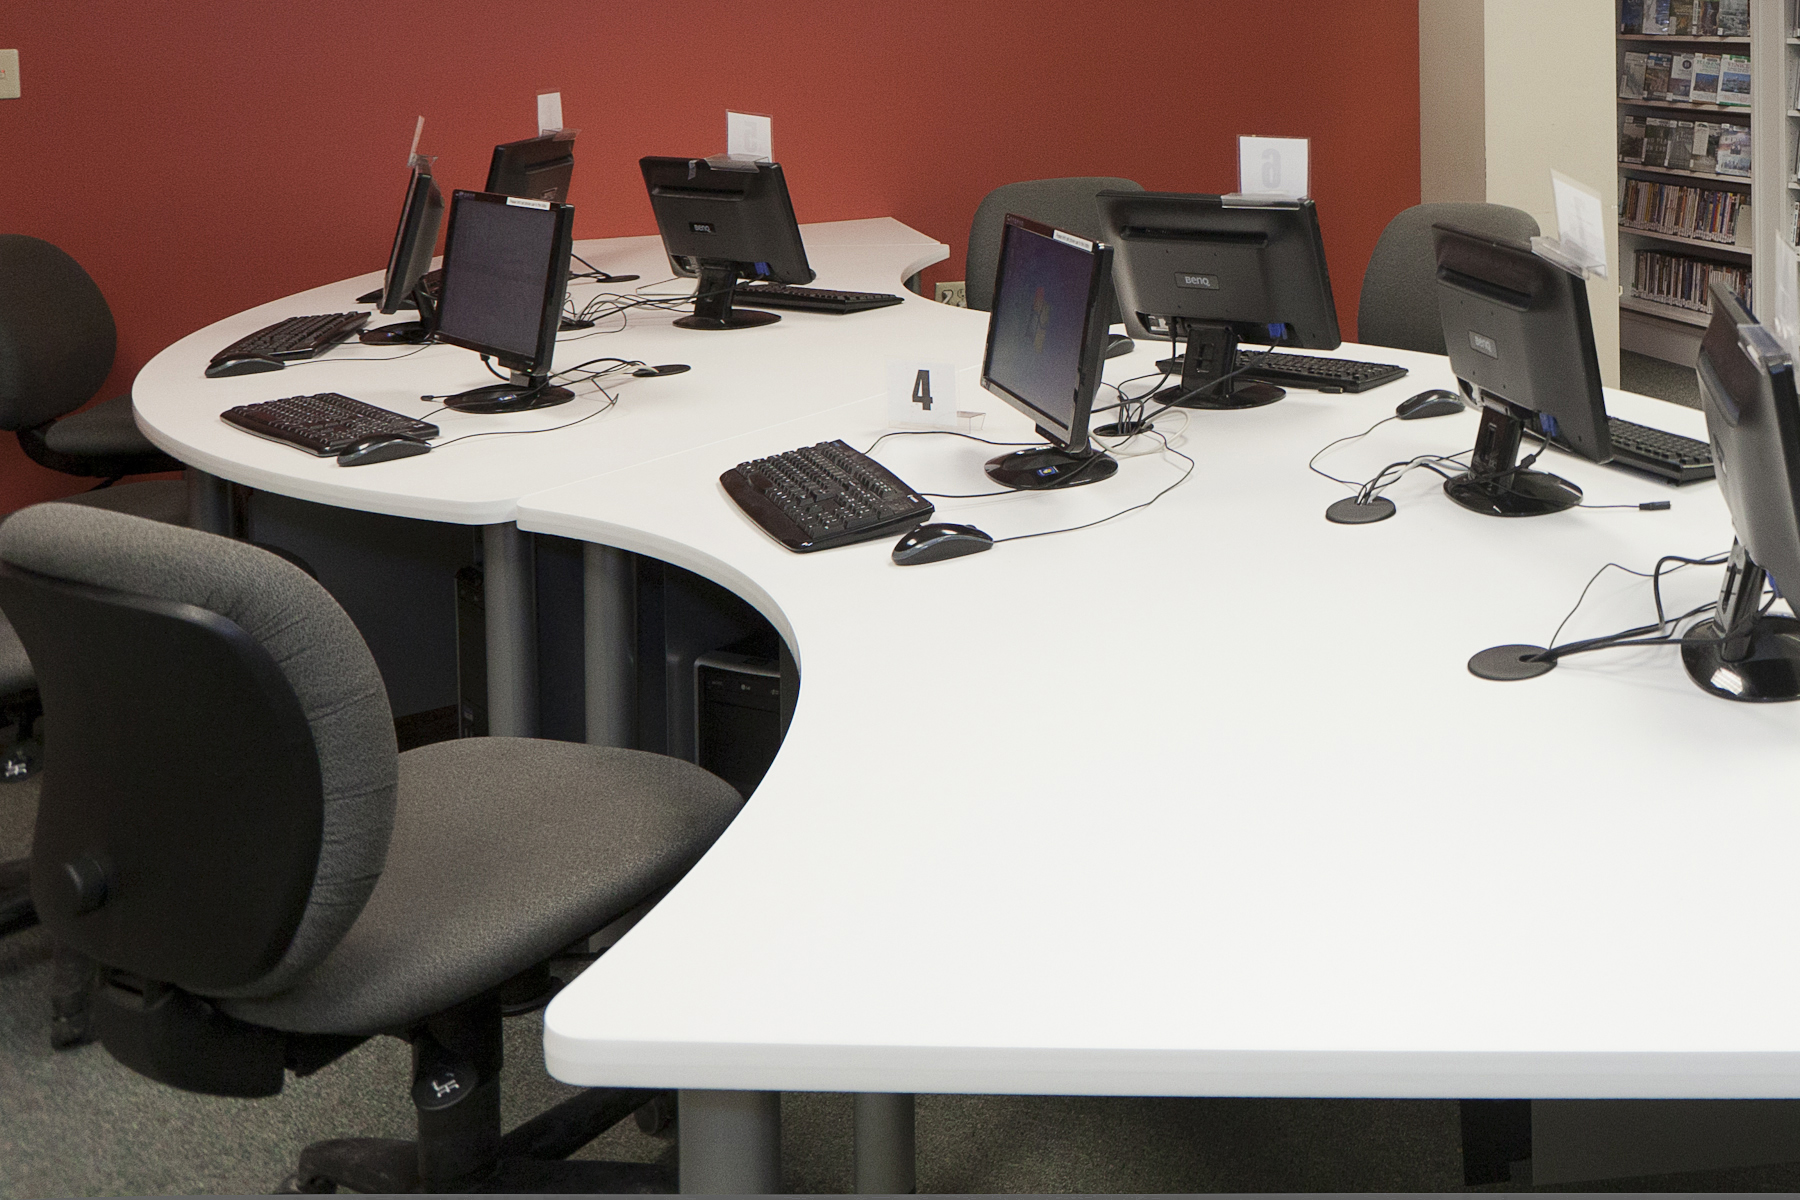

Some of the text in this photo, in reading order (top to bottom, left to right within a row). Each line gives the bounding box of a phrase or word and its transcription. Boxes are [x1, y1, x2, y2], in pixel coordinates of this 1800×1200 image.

[694, 224, 711, 233] BenQ
[1184, 276, 1211, 287] BenQ
[912, 369, 933, 411] 4
